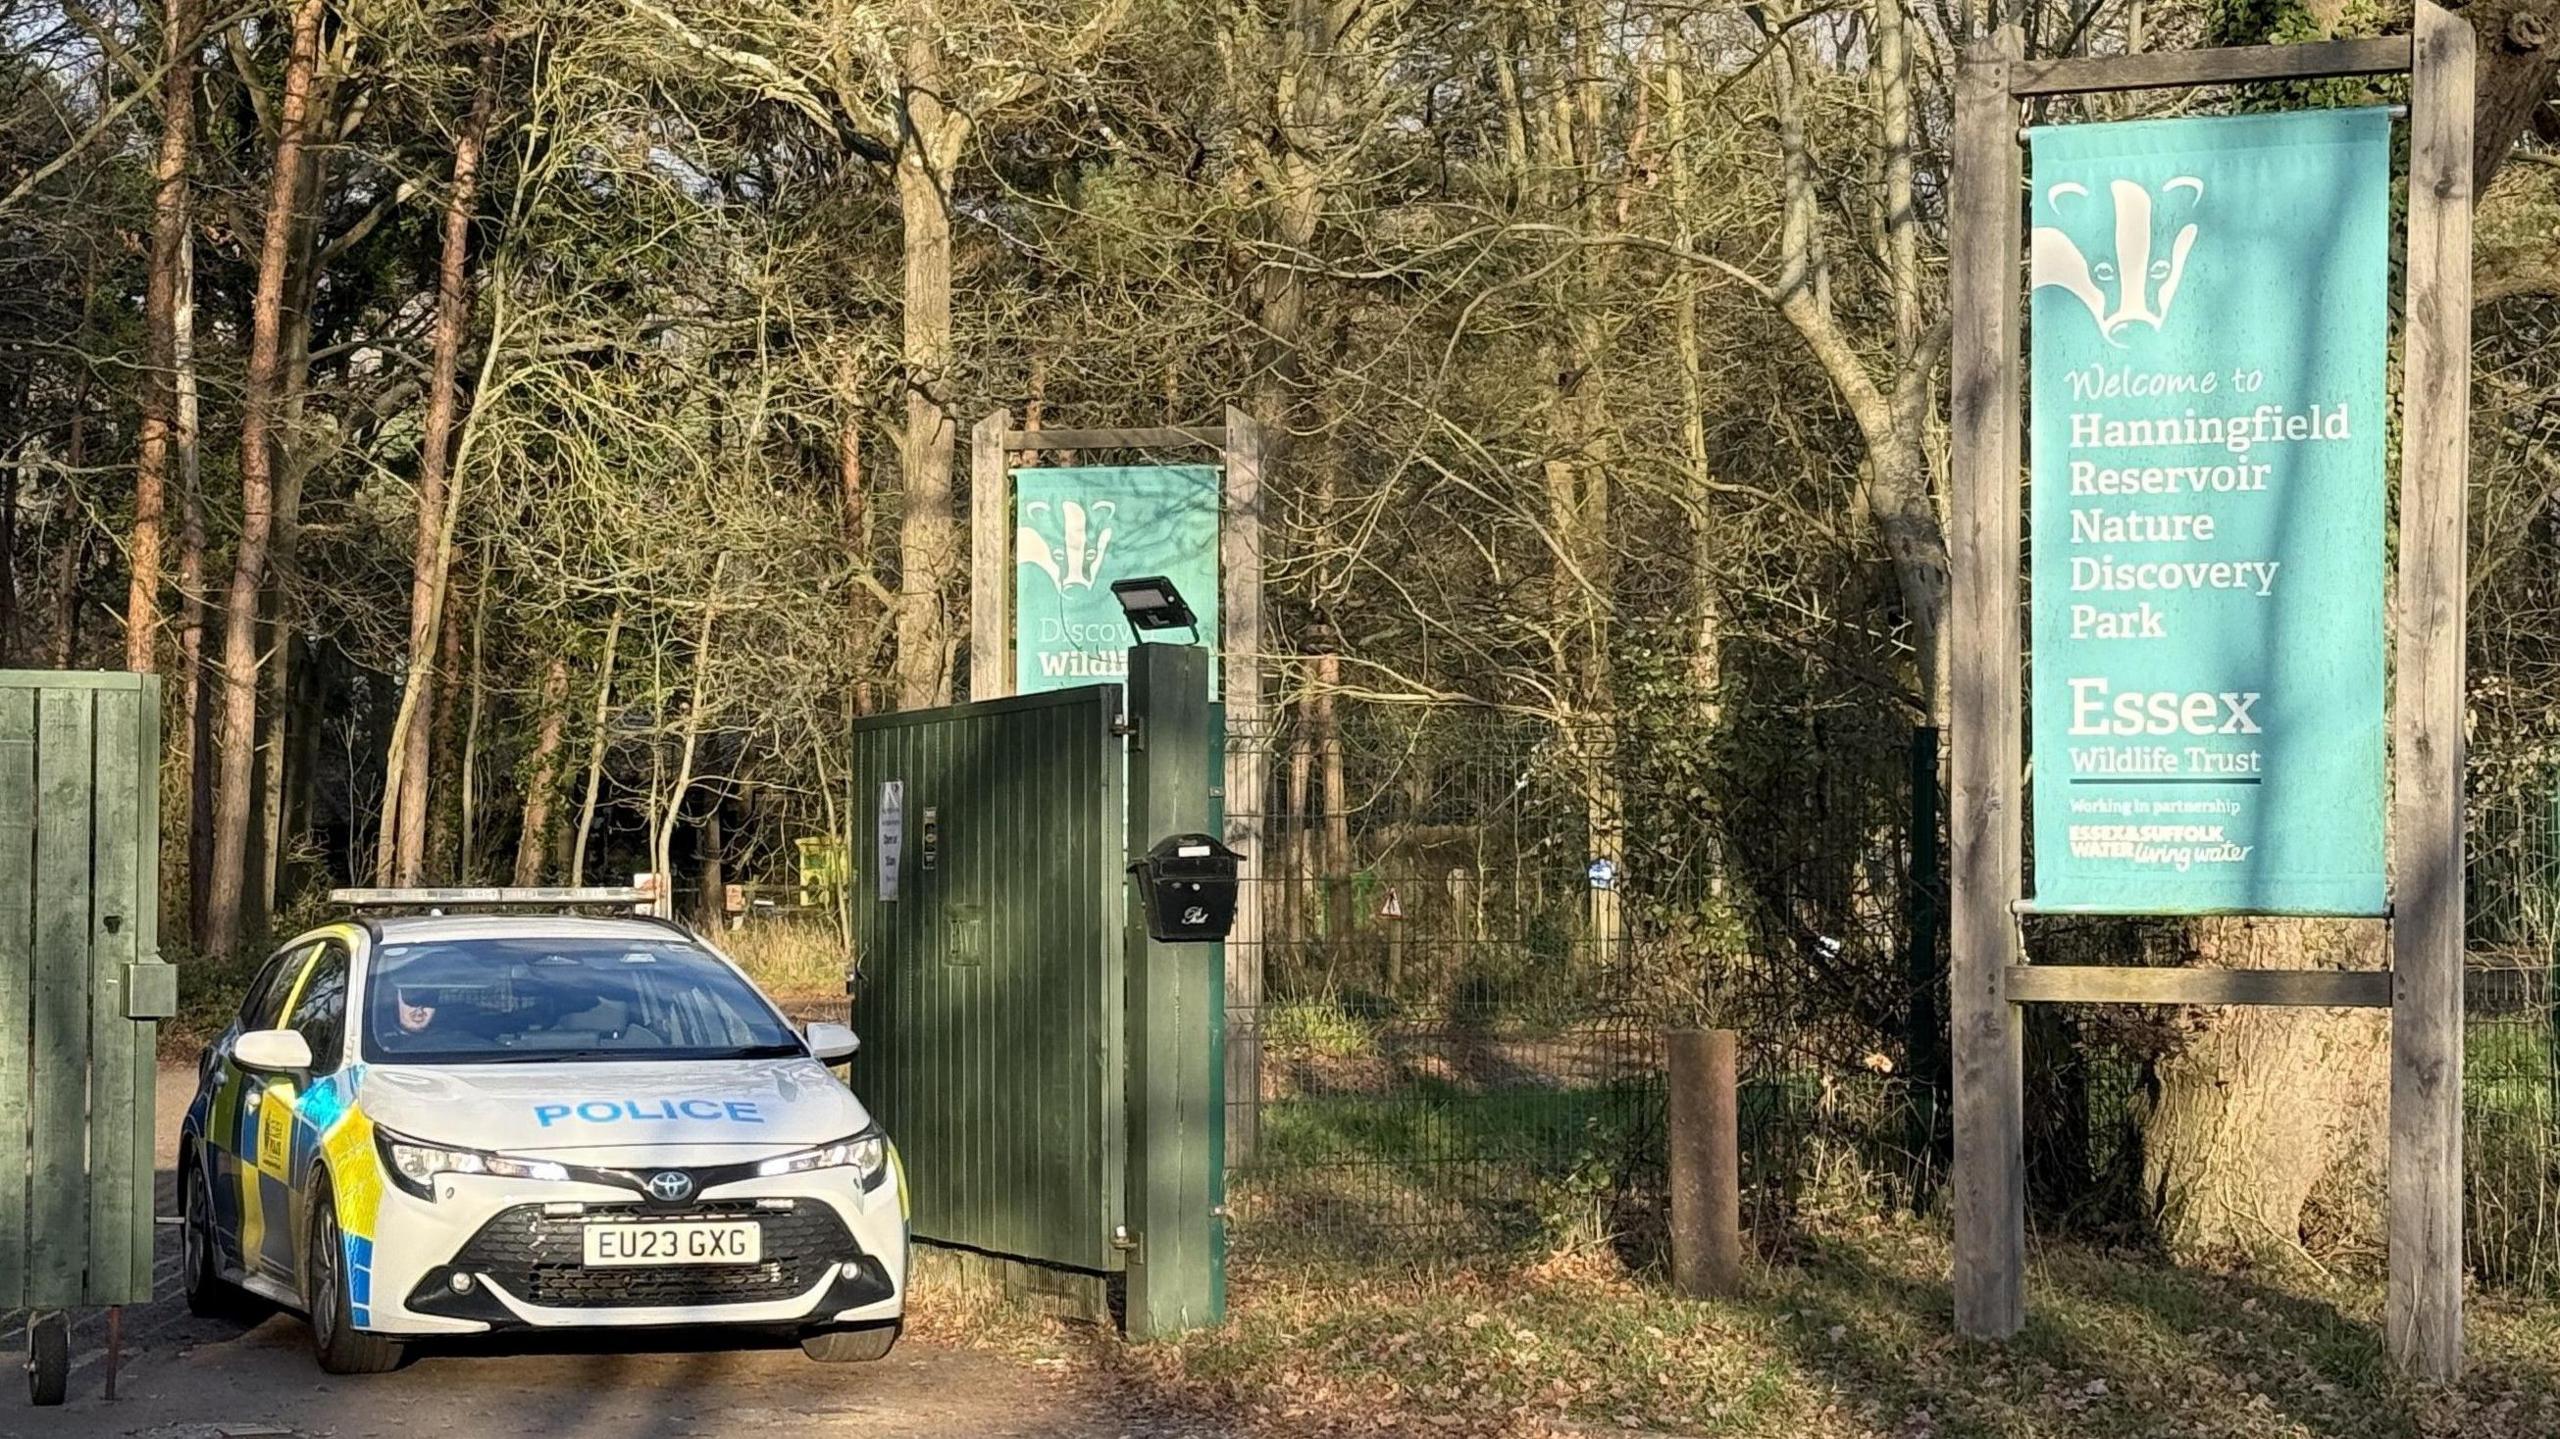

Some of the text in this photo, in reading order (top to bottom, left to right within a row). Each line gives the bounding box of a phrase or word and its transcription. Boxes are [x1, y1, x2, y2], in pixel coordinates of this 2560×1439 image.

[2063, 363, 2263, 400] Welcome to
[2069, 404, 2351, 452] Hanningfield
[2069, 455, 2271, 496] Reservoir
[2069, 509, 2215, 543] Nature
[2069, 555, 2280, 597] Discovery
[1038, 618, 1158, 643] Discov
[2069, 602, 2167, 640] Park
[1038, 649, 1128, 677] Wildli
[2067, 677, 2261, 735] Essex
[2069, 747, 2261, 774] Wildlife Trust
[2070, 798, 2241, 816] Working in partnership
[2194, 840, 2254, 863] water
[533, 1099, 765, 1127] POLICE
[598, 1229, 746, 1258] EU23 GXG
